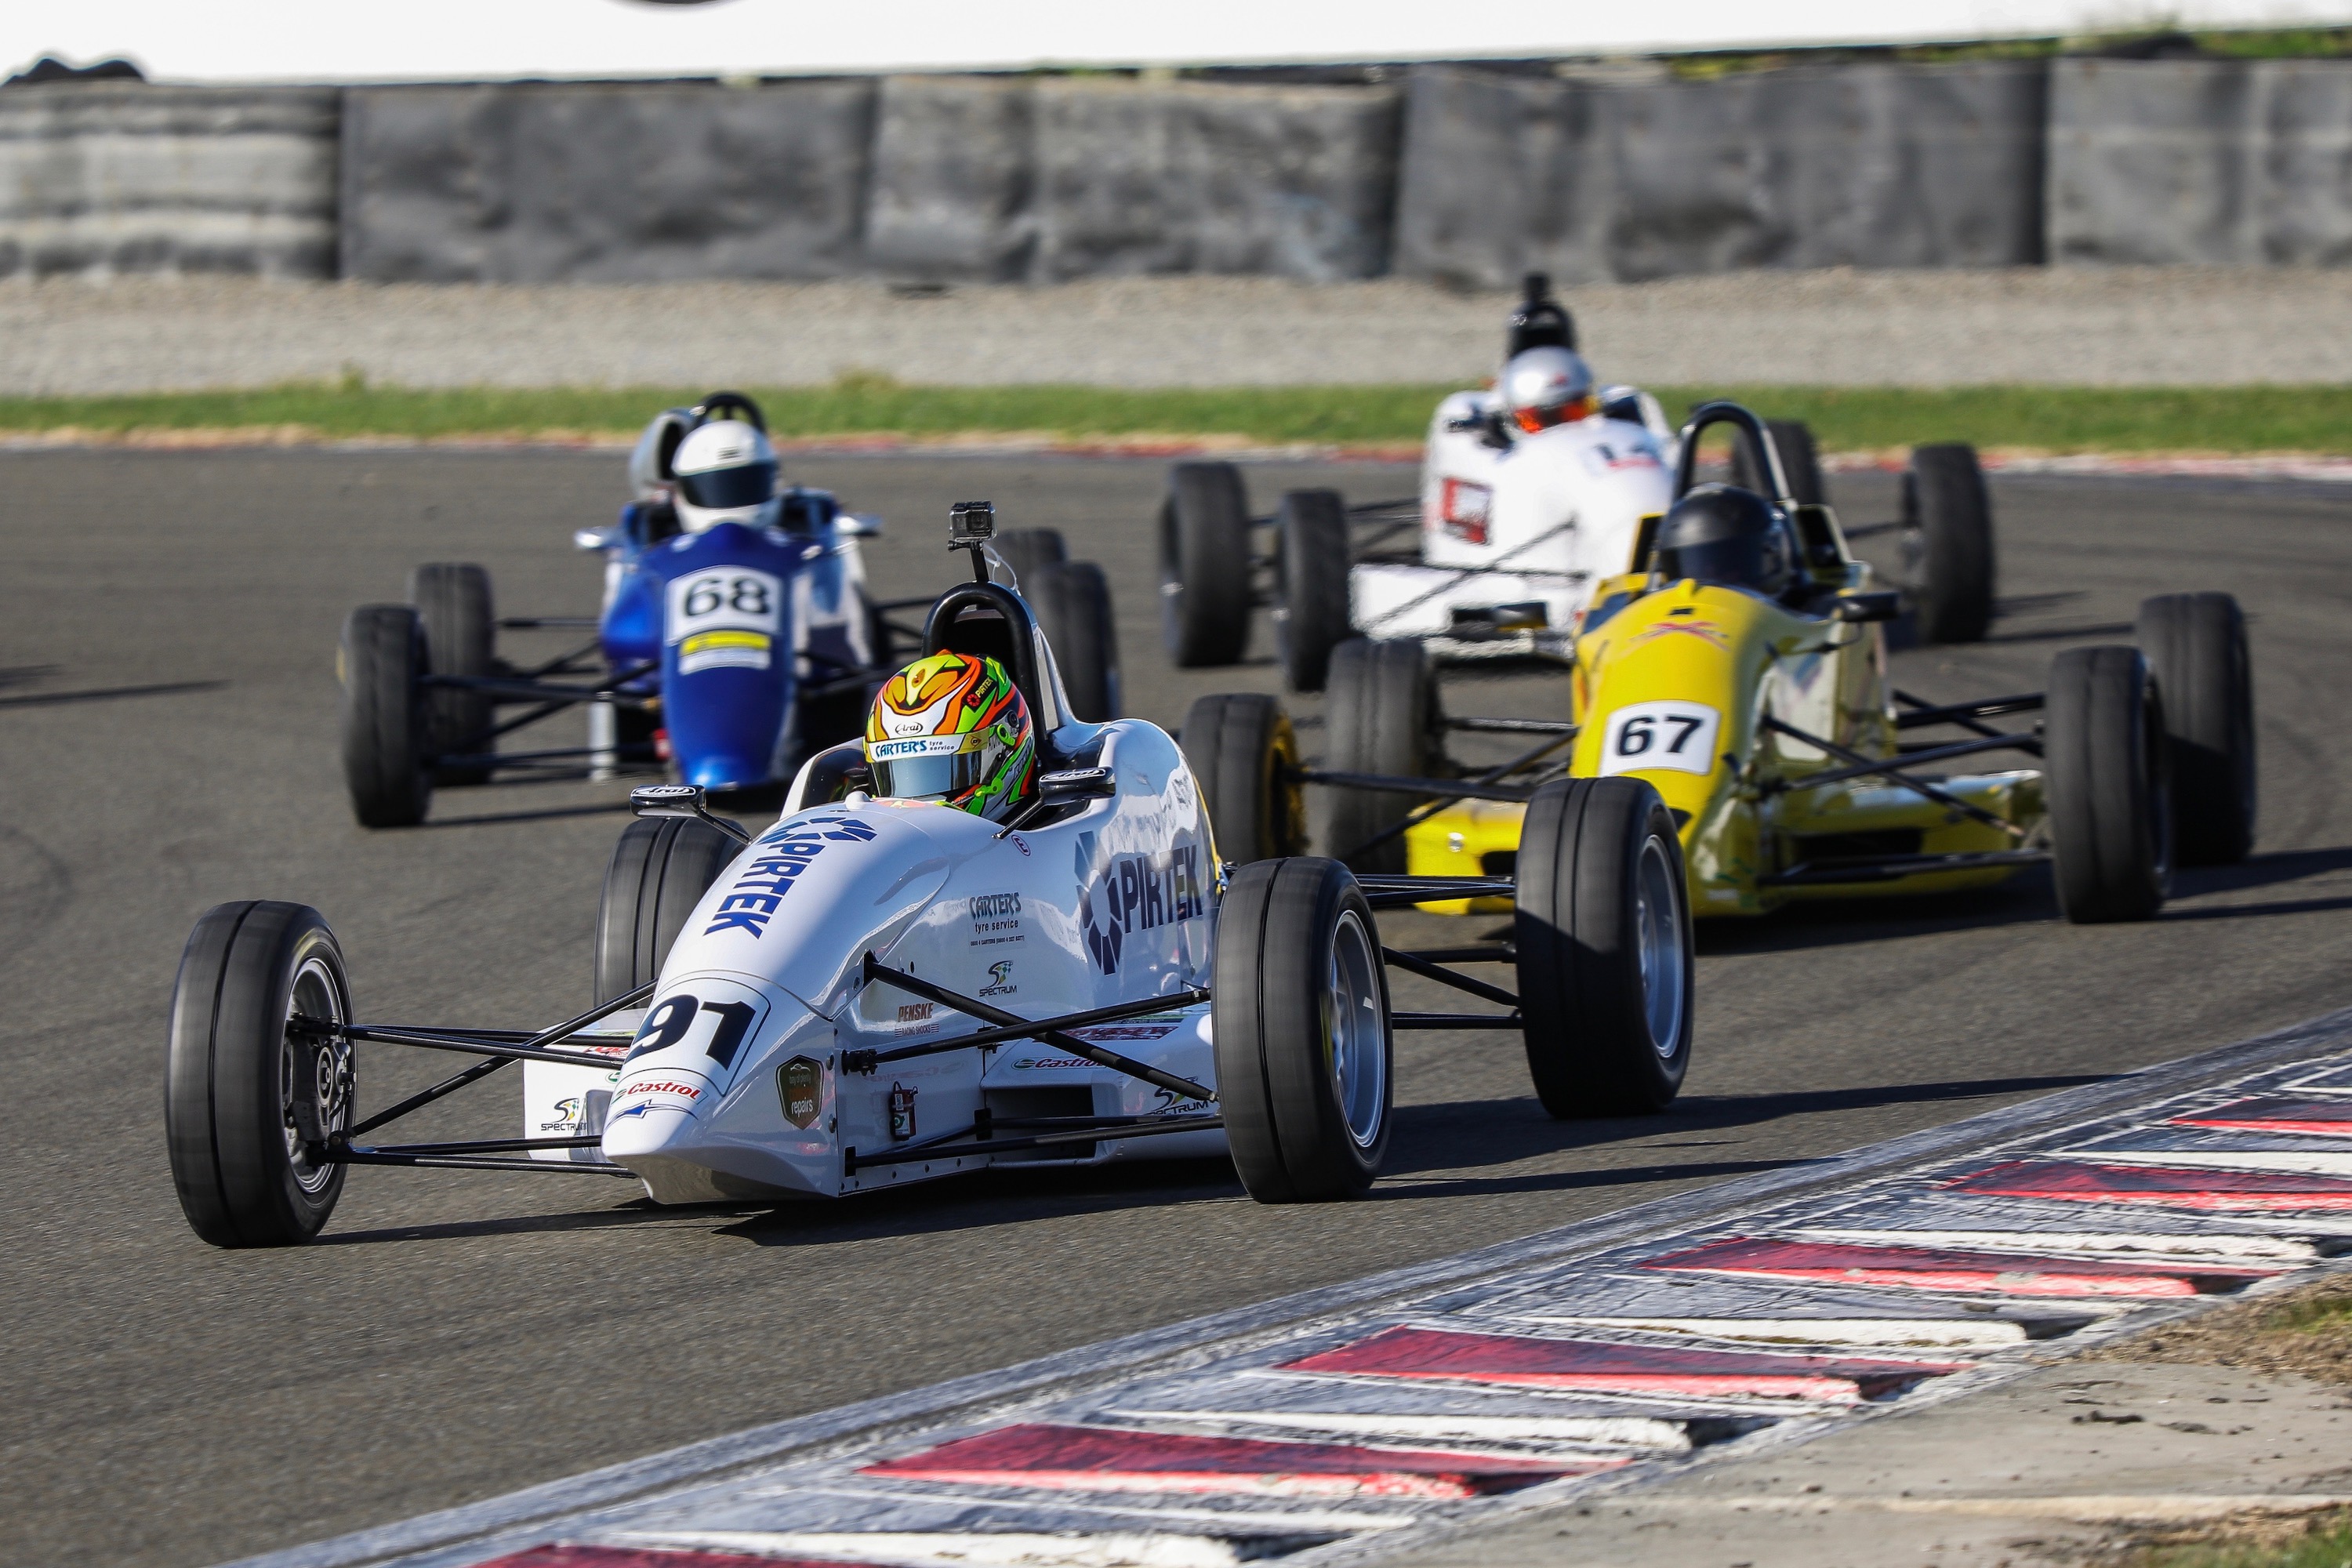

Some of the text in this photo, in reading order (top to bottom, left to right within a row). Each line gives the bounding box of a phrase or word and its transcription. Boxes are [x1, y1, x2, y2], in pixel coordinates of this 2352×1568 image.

[685, 578, 771, 616] 68
[975, 677, 993, 698] PIRTEK
[896, 722, 922, 733] Arai
[1617, 714, 1703, 756] 67
[876, 740, 927, 758] CARTER'S
[703, 842, 826, 939] PIRTEK
[1120, 844, 1203, 934] PIRTEK
[969, 892, 1022, 920] CARTER'S
[975, 918, 1018, 935] tyre service
[978, 985, 1018, 996] SPECTRUM
[898, 1003, 935, 1022] PENSKE
[624, 994, 757, 1071] 91
[902, 1024, 931, 1036] RACING SHOCKS
[627, 1081, 702, 1101] Castrol
[791, 1096, 813, 1117] repairs
